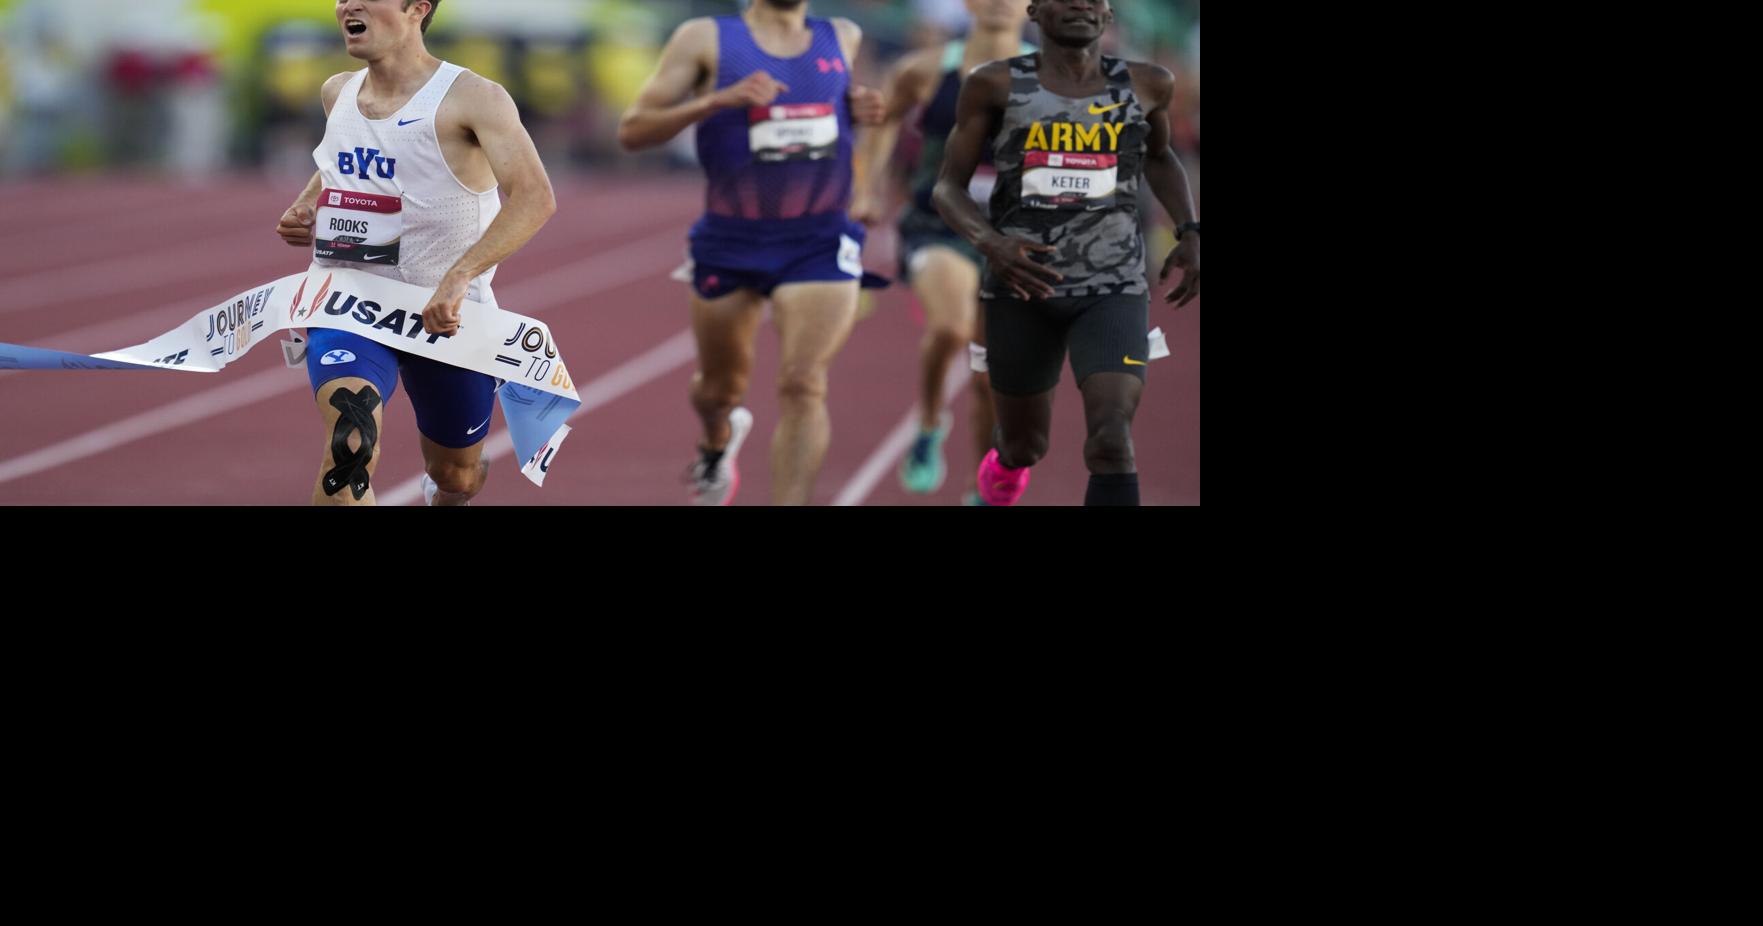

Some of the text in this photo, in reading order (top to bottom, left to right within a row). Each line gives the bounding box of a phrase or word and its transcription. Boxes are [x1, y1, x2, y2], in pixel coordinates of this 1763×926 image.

[1024, 121, 1124, 151] ARMY
[338, 147, 396, 179] BYU
[1051, 176, 1091, 189] KETER
[344, 196, 378, 207] TOYOTA
[329, 217, 369, 234] ROOKS
[206, 286, 275, 342] JOURNEY
[223, 332, 235, 355] TO
[525, 355, 551, 381] TO
